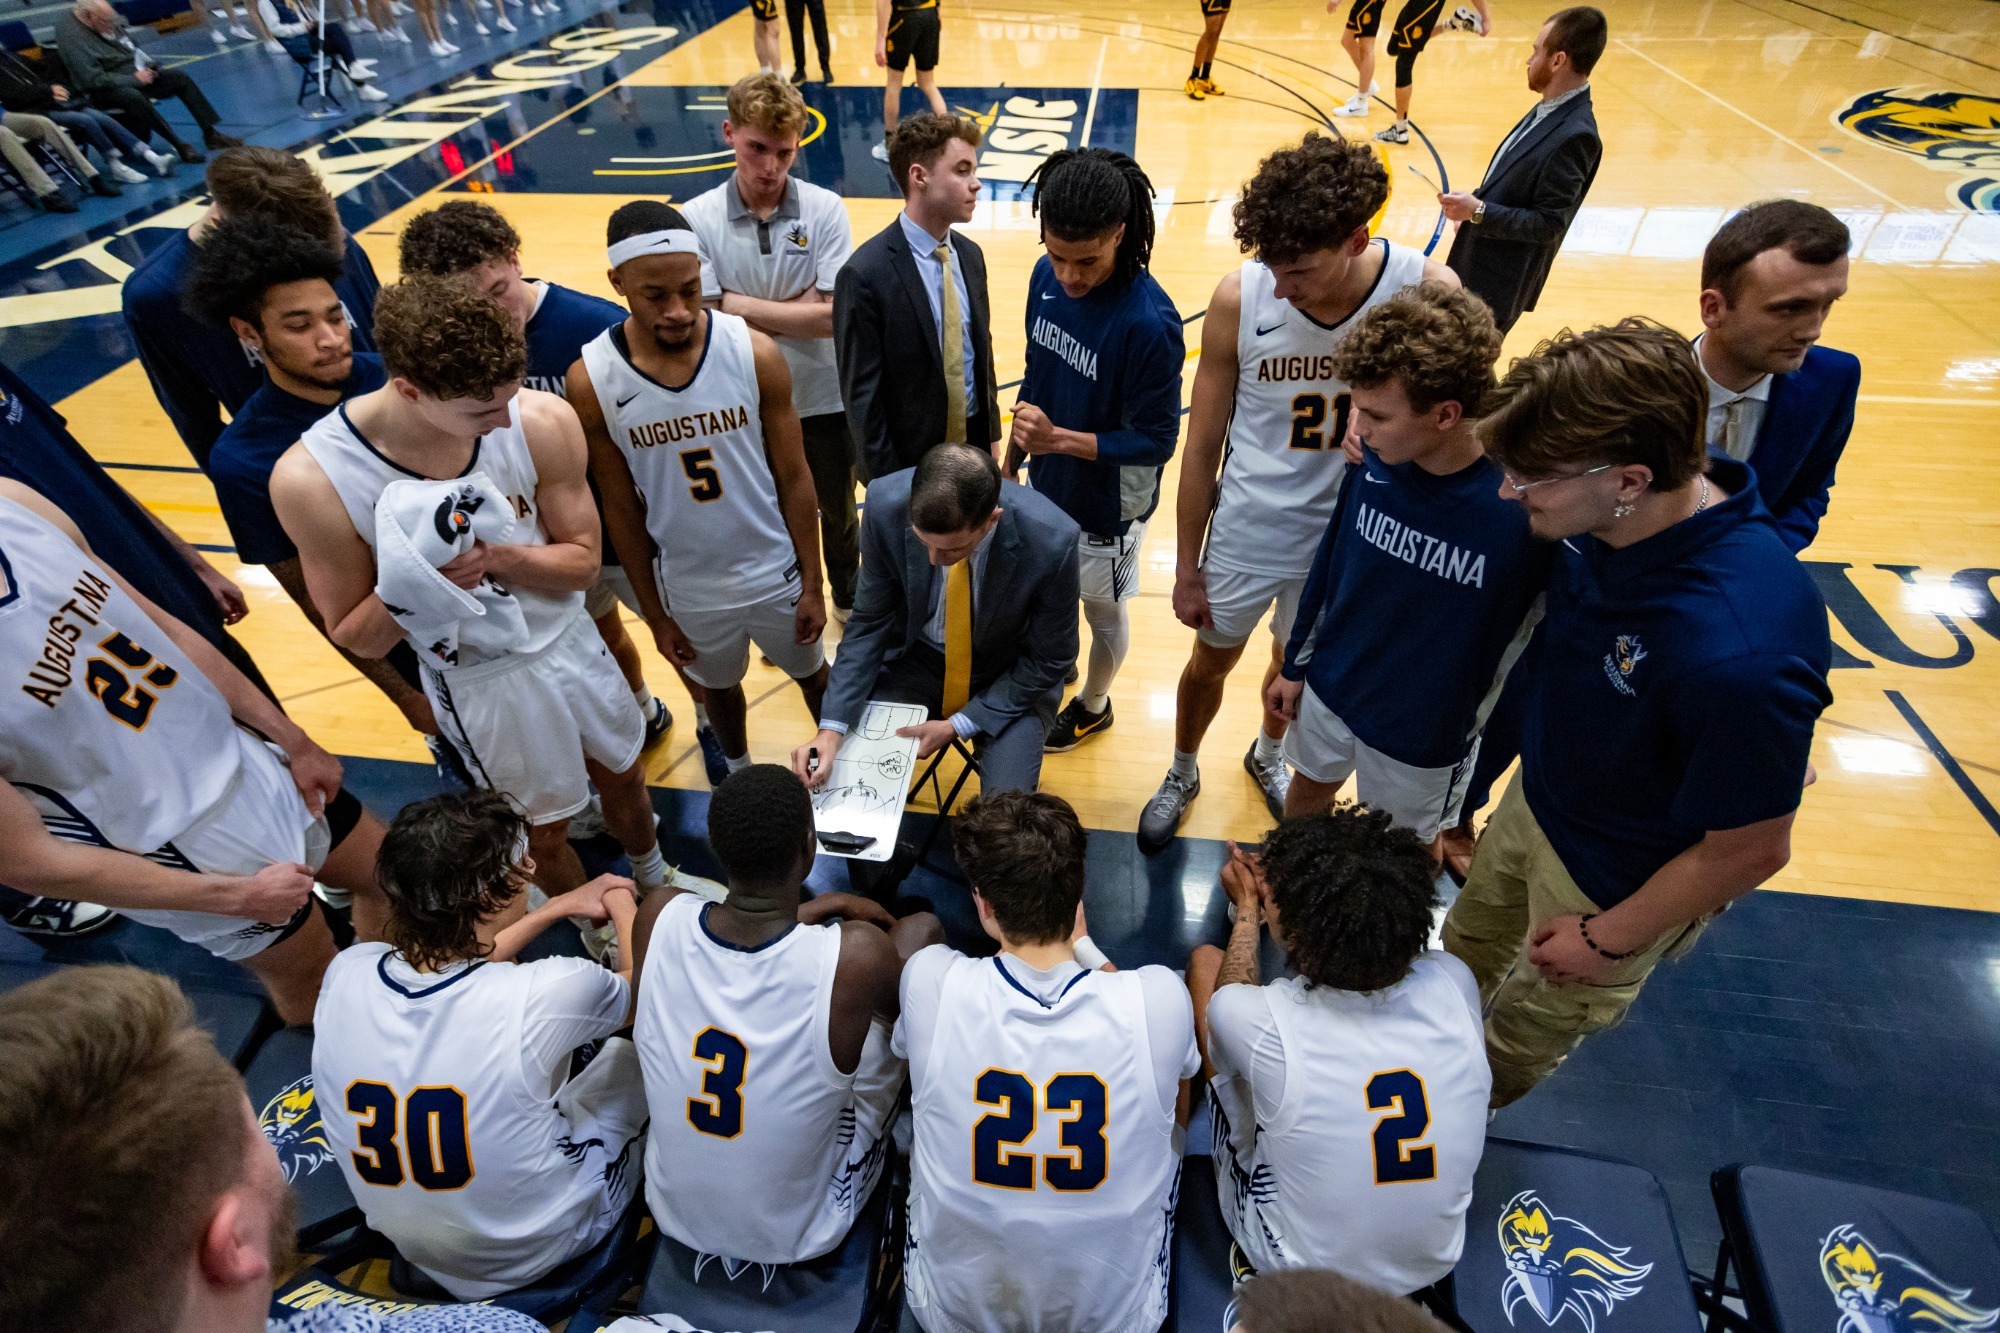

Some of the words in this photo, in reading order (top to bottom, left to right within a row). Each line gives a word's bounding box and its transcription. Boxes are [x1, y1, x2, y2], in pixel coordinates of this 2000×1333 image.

[1031, 315, 1098, 381] AUGUSTANA
[628, 405, 749, 450] AUGUSTANA
[1288, 391, 1352, 452] 21
[678, 446, 724, 504] 5
[1355, 502, 1486, 589] AUGUSTANA
[21, 569, 112, 710] AUGUSTNA
[686, 1024, 750, 1140] 3
[971, 1066, 1110, 1193] 23
[1363, 1067, 1438, 1186] 2
[344, 1078, 476, 1192] 30
